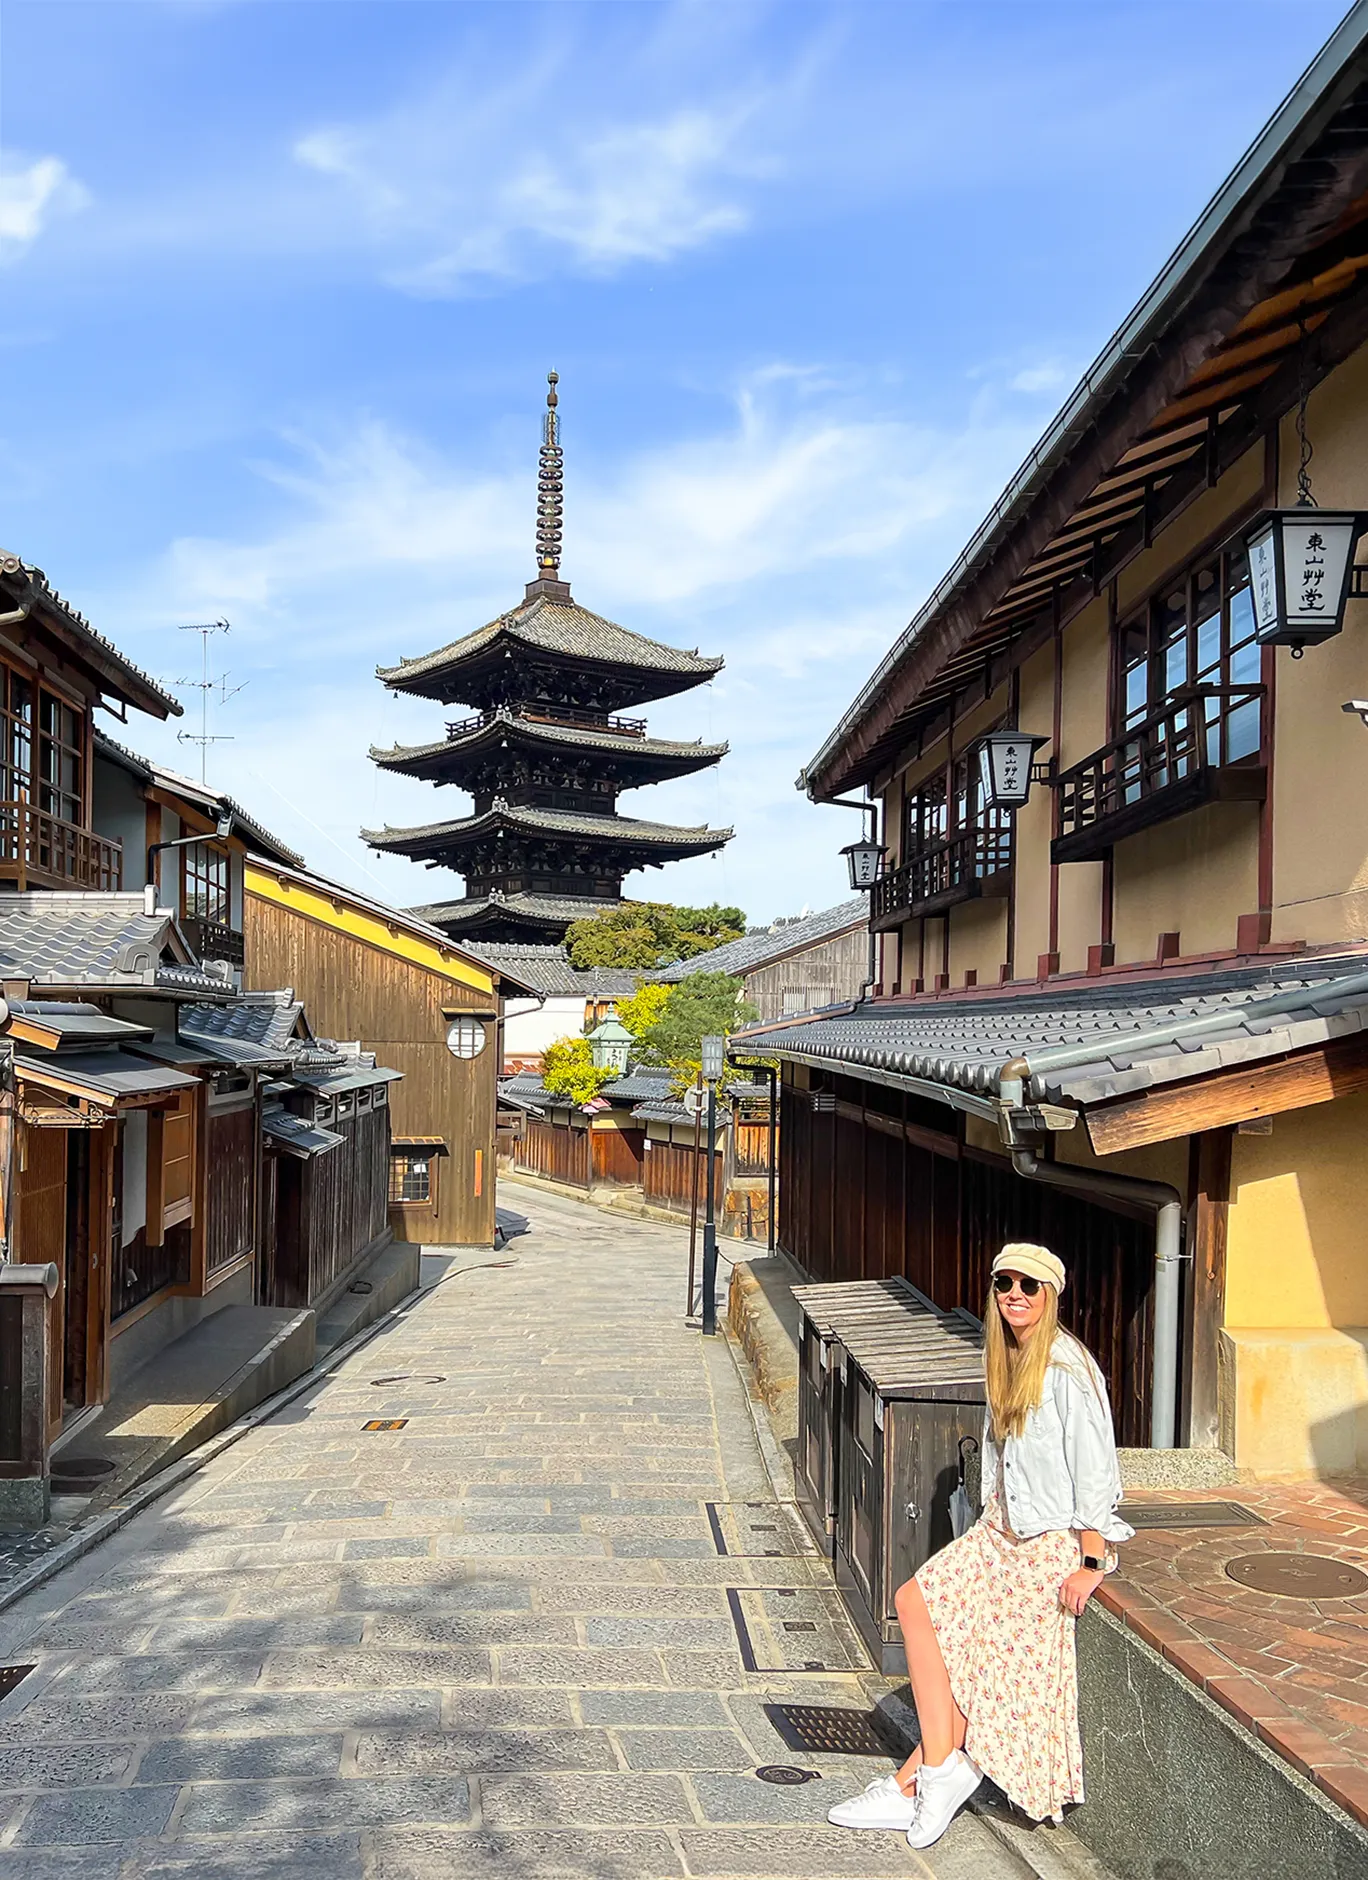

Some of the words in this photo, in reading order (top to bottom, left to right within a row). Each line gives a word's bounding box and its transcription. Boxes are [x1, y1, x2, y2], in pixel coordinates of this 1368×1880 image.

[1298, 532, 1328, 612] 東山艸堂
[1002, 745, 1019, 791] 東山艸堂
